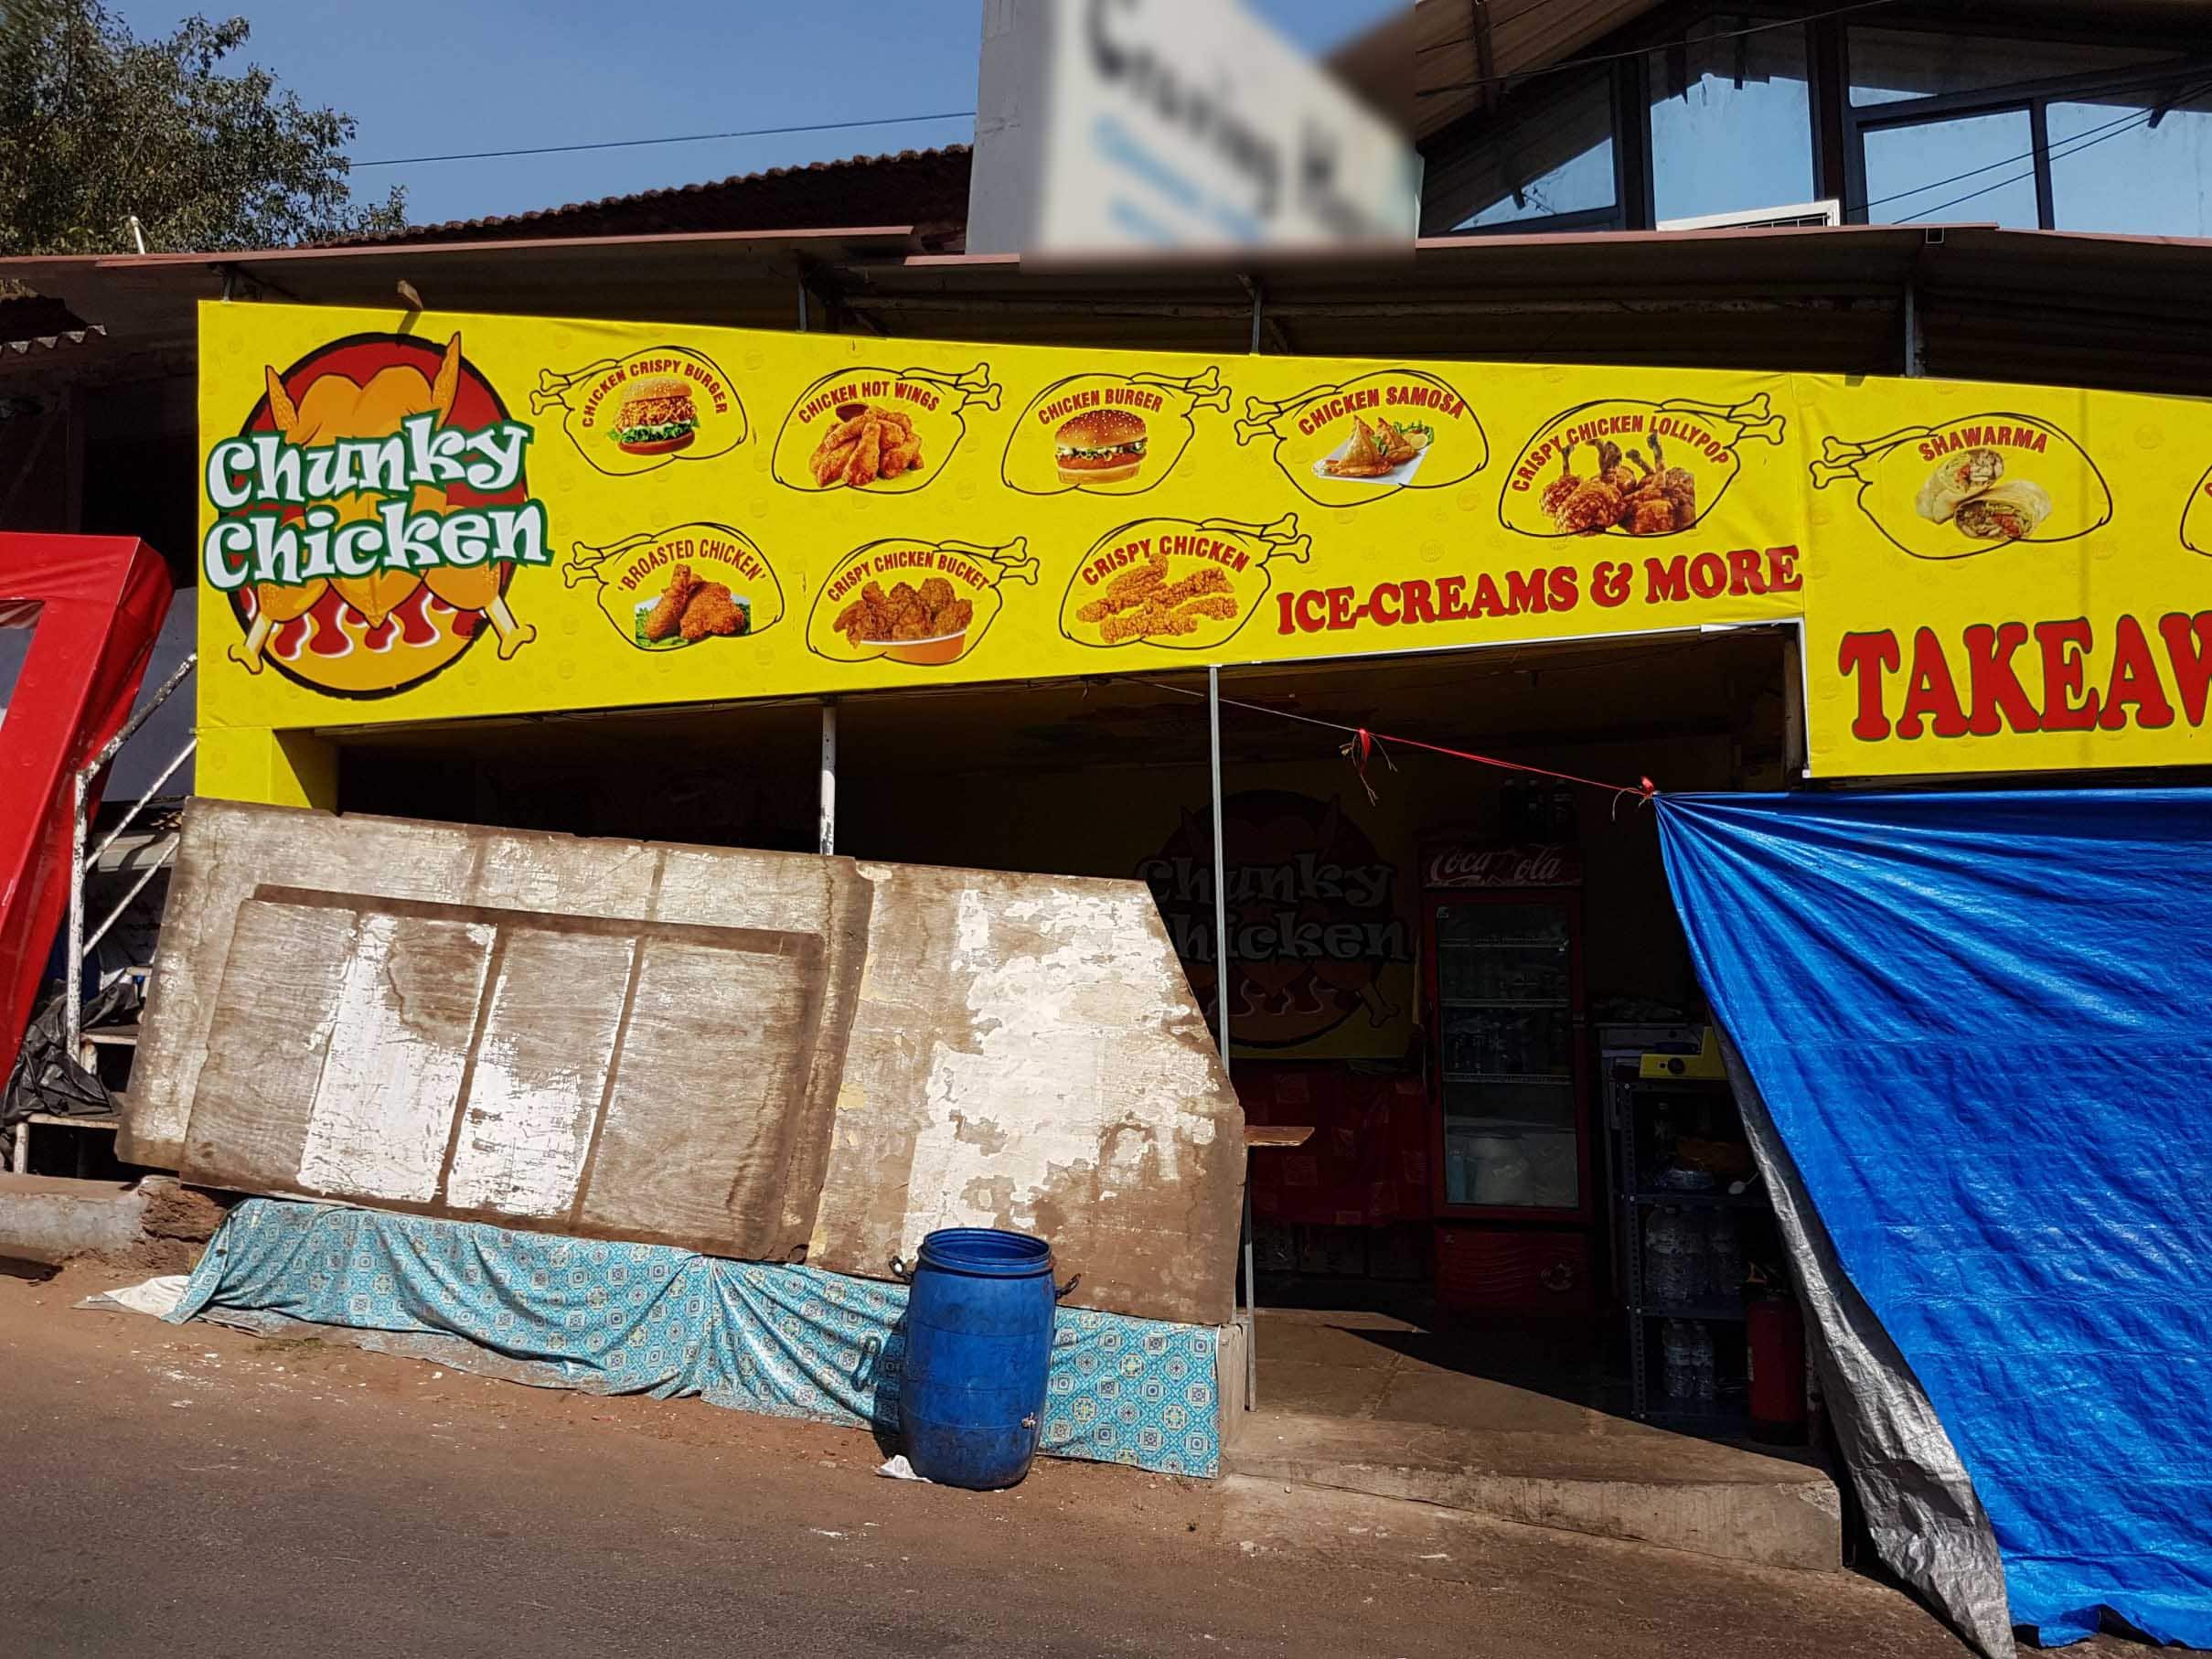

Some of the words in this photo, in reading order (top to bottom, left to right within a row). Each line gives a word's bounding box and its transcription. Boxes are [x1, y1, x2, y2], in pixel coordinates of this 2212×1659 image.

[582, 369, 626, 427] CHICKEN
[630, 359, 680, 376] CRISPY
[684, 363, 727, 412] BURGER
[798, 384, 858, 423] CHICKEN
[862, 381, 890, 397] HOT
[895, 382, 939, 411] WINGS
[1038, 390, 1100, 424] CHICKEN
[1105, 389, 1163, 412] BURGER
[1298, 389, 1379, 435] CHICKEN
[1386, 387, 1464, 419] SAMOSA
[208, 412, 532, 508] Chunky
[1512, 435, 1562, 492] CRISPY
[1566, 416, 1643, 445] CHICKEN
[1650, 416, 1728, 464] LOLLYPOP
[1918, 426, 2047, 461] SHAWARMA
[205, 500, 550, 588] Chicken
[1083, 539, 1150, 585] CRISPY
[1159, 536, 1250, 572] CHICKEN
[828, 562, 871, 602] CRISPY
[874, 551, 934, 573] CHICKEN
[937, 554, 989, 591] BUCKET
[1277, 567, 1577, 635] ICE-CREAMS
[1590, 562, 1632, 606] &
[1645, 545, 1803, 604] MORE
[1170, 911, 1411, 961] hicken
